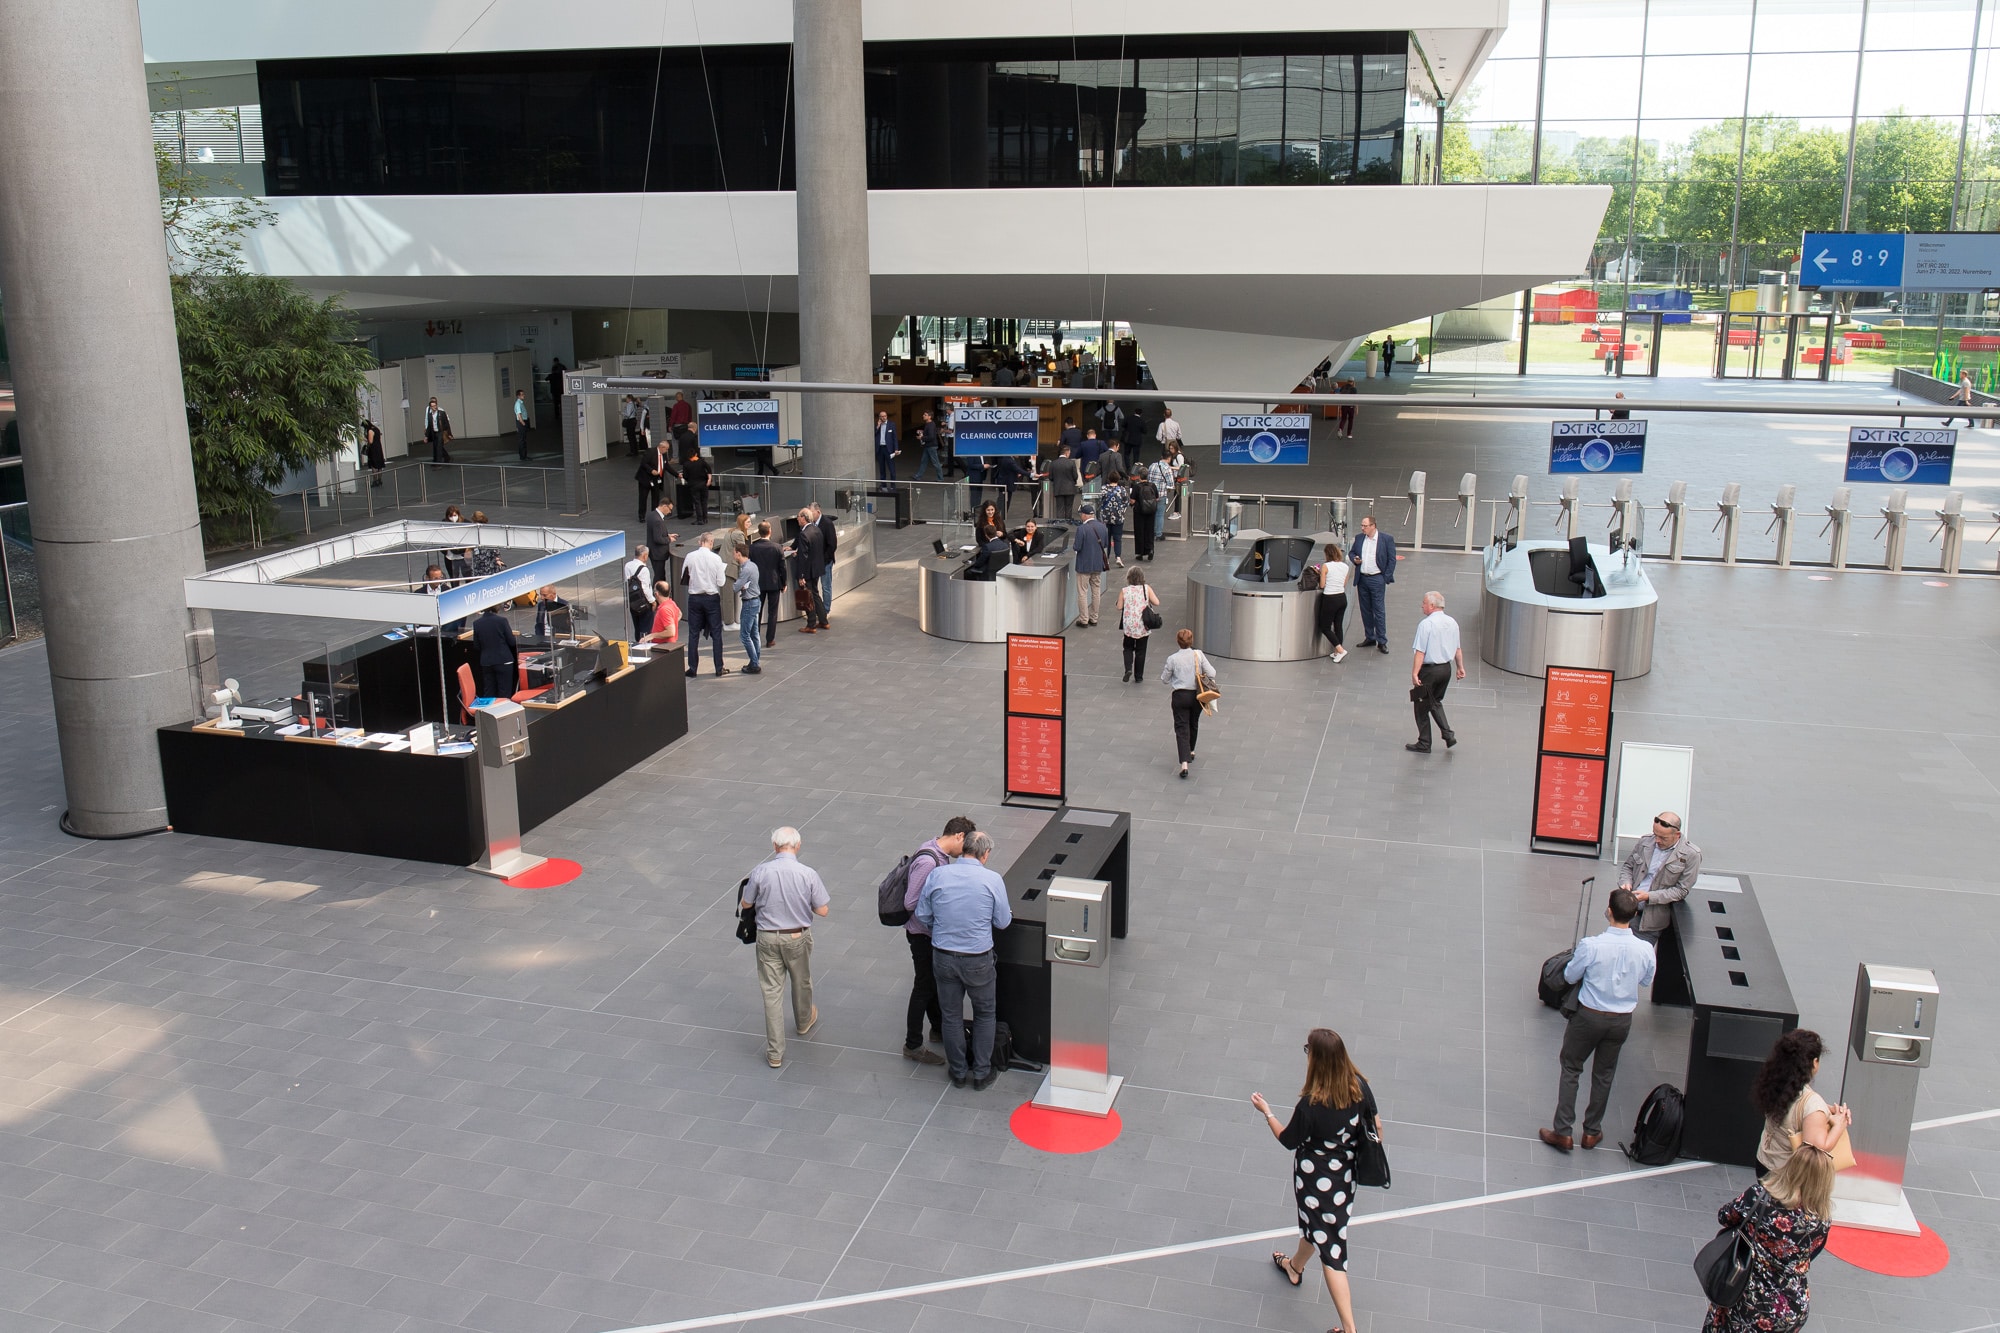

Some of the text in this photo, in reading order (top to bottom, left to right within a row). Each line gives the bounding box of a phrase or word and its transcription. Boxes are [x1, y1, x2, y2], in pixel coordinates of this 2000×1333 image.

[1852, 249, 1862, 267] 8
[1878, 249, 1889, 267] 9
[704, 403, 724, 412] DKT
[746, 402, 774, 411] 2021
[961, 410, 982, 420] DKT
[1005, 410, 1034, 420] 2021
[1228, 417, 1251, 427] DKT
[1275, 417, 1305, 427] 2021
[1560, 423, 1583, 434] DKT
[1609, 423, 1640, 434] 2021
[960, 432, 997, 440] CLEARING
[1858, 430, 1885, 441] DKT
[1913, 431, 1950, 443] 2021
[575, 548, 602, 567] Helpdesk
[464, 592, 477, 606] VIP
[482, 585, 504, 600] Presse
[509, 573, 536, 591] Speaker
